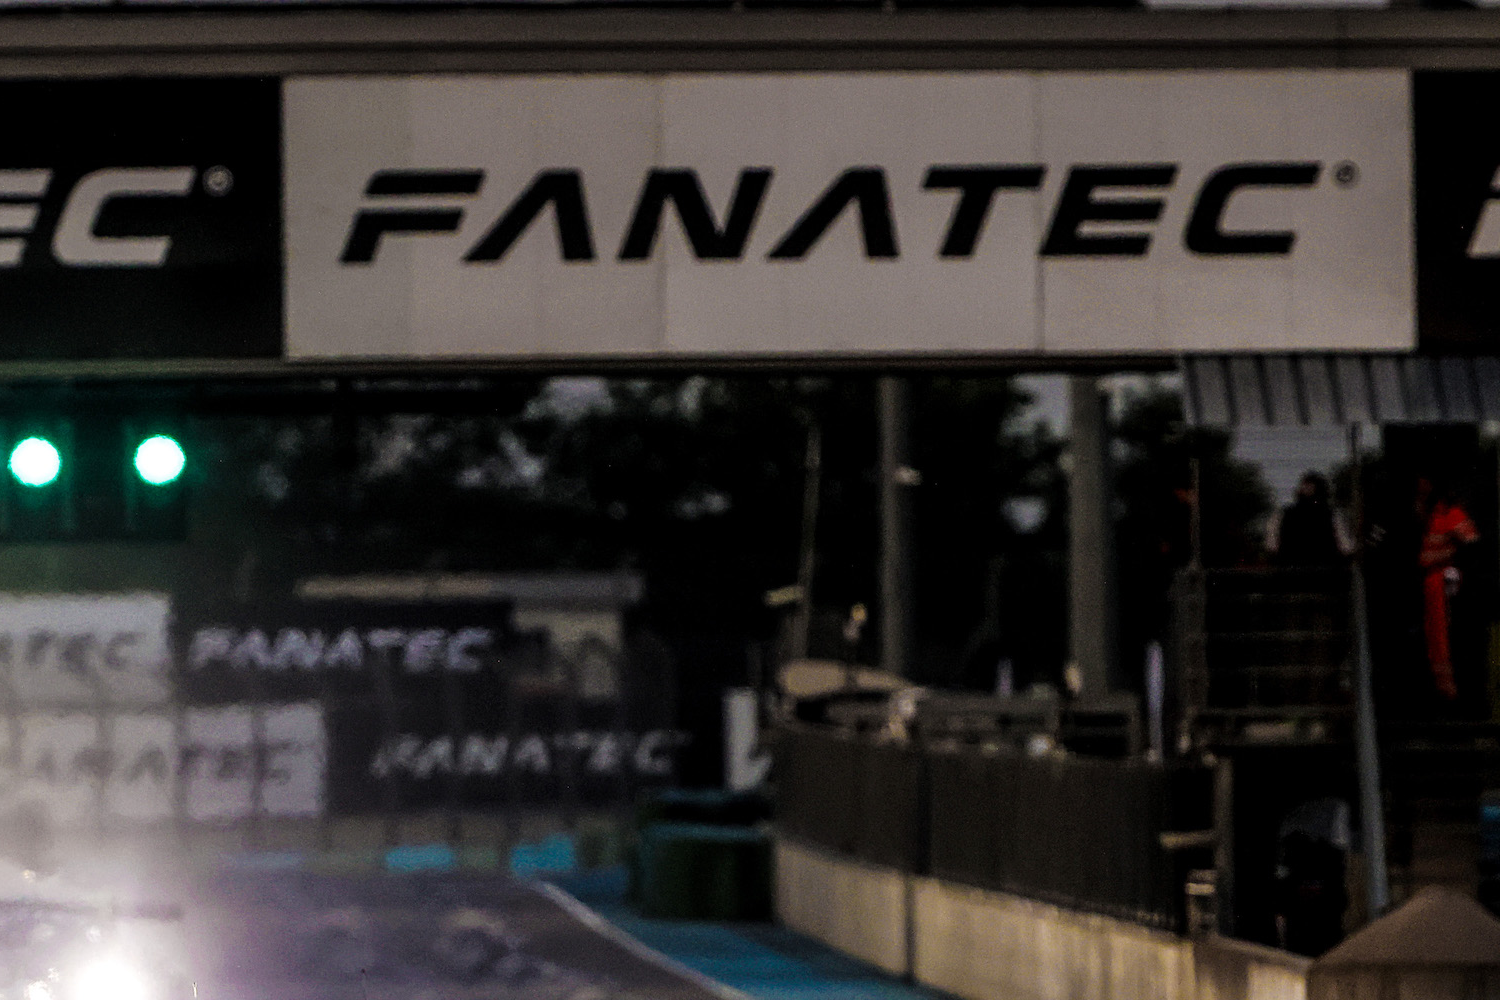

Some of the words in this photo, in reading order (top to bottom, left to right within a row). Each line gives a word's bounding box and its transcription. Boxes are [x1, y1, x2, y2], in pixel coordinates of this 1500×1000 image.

[338, 162, 1322, 264] FANATEC
[189, 625, 493, 673] FANATEC
[369, 729, 693, 780] FANATEC
